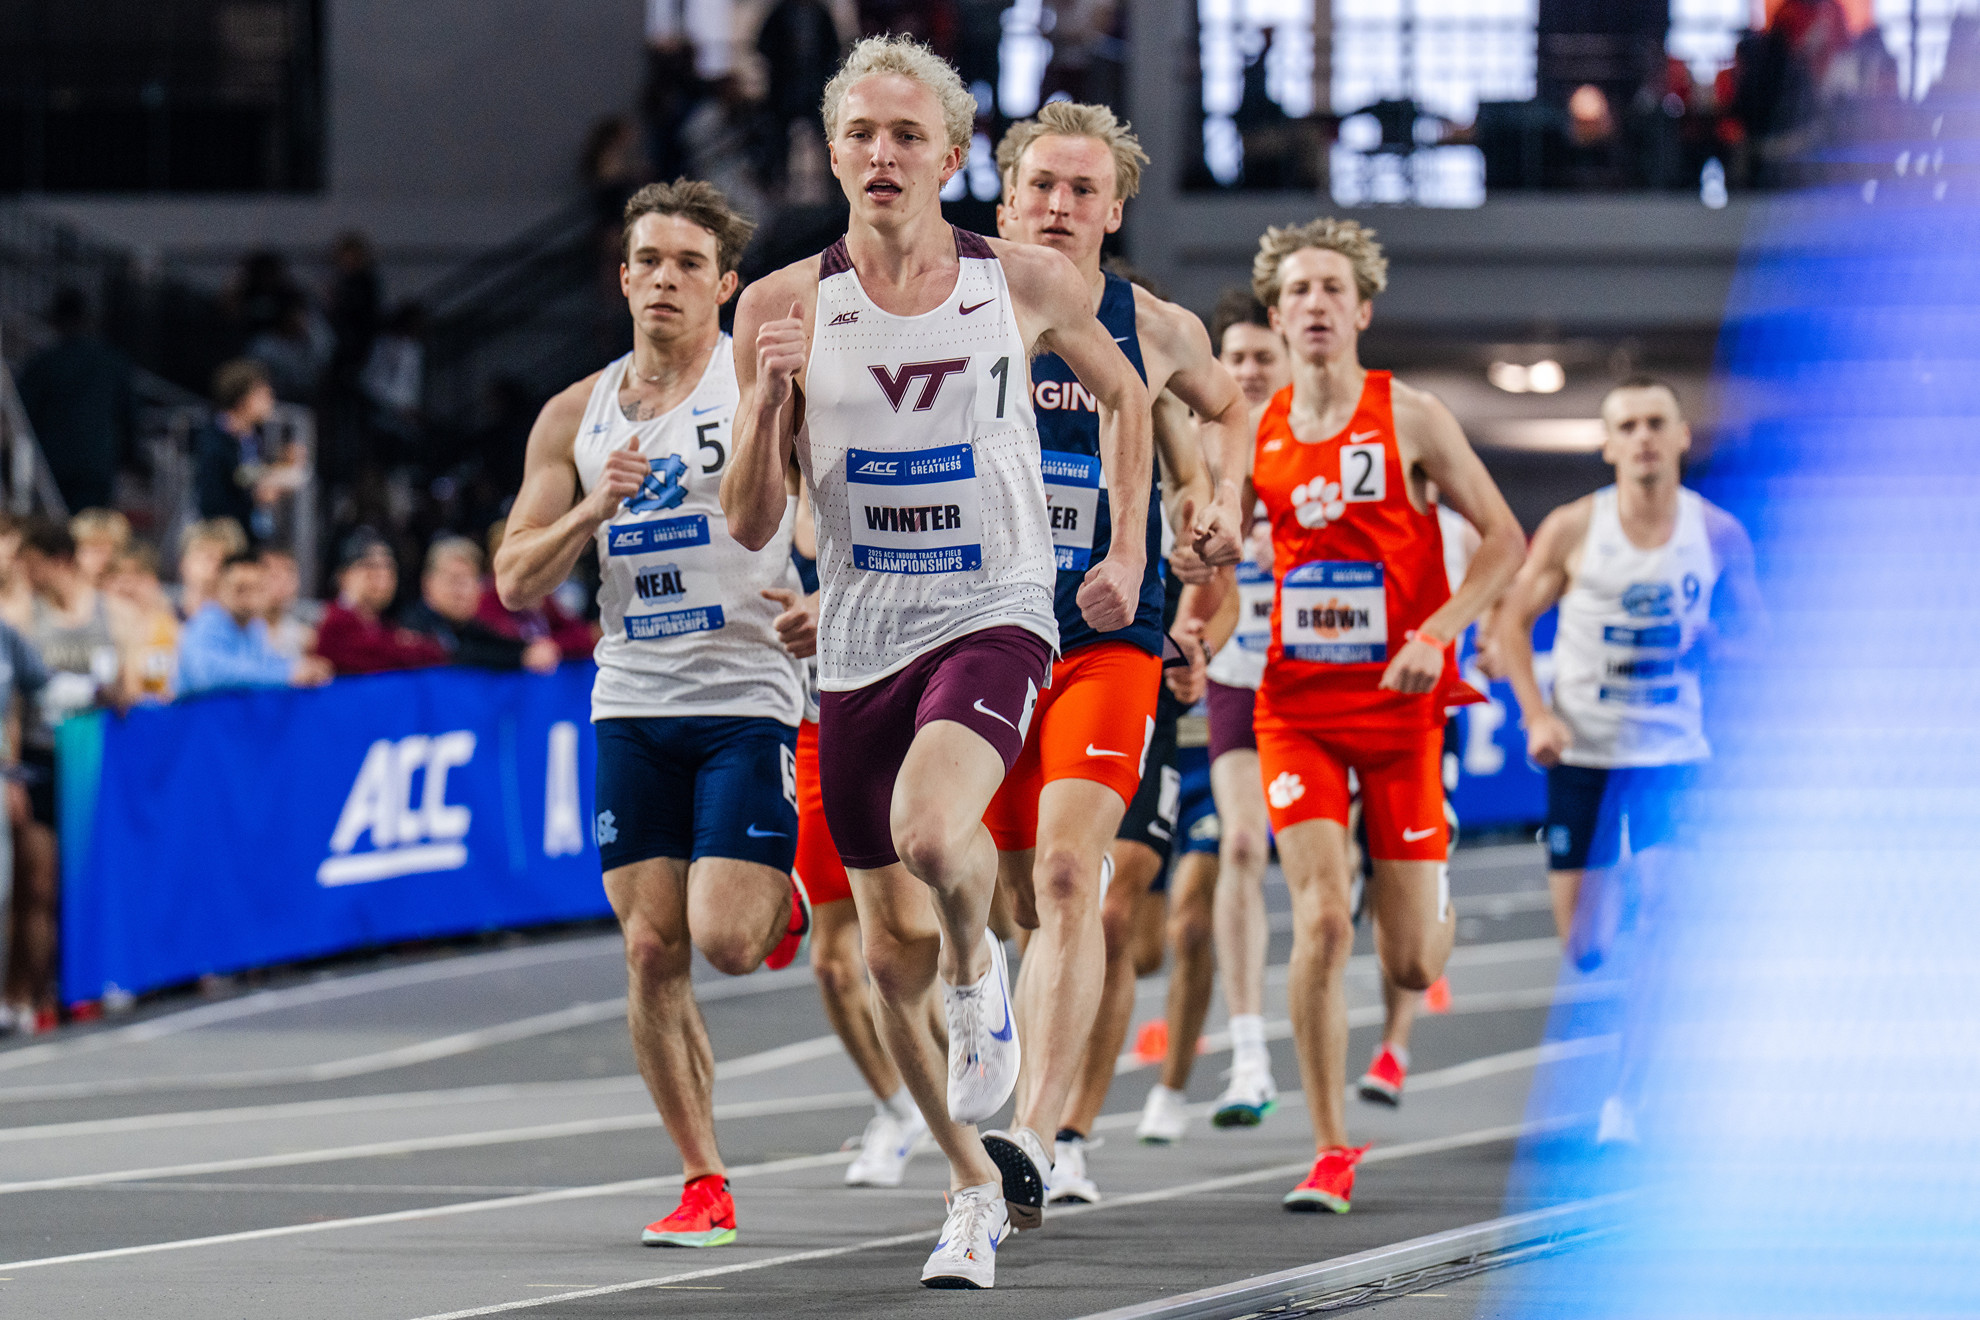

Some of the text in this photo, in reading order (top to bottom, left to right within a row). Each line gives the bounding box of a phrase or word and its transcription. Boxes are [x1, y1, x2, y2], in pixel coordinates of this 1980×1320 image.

[828, 311, 860, 326] ACC
[867, 356, 971, 414] VT
[989, 356, 1009, 419] 1
[696, 422, 726, 474] 5
[856, 460, 899, 476] ACC
[910, 460, 962, 476] GREATNESS
[1352, 450, 1375, 496] 2
[864, 504, 961, 533] WINTER
[614, 529, 645, 547] ACC
[867, 548, 883, 557] 2025
[883, 551, 895, 559] ACC
[896, 552, 918, 560] INDOOR
[919, 551, 938, 560] TRACK
[945, 548, 962, 557] FIELD
[867, 556, 964, 573] CHAMPIONSHIPS
[635, 570, 686, 599] NEAL
[1682, 572, 1700, 614] 9
[1297, 608, 1370, 629] BROWN
[320, 729, 477, 875] ACC
